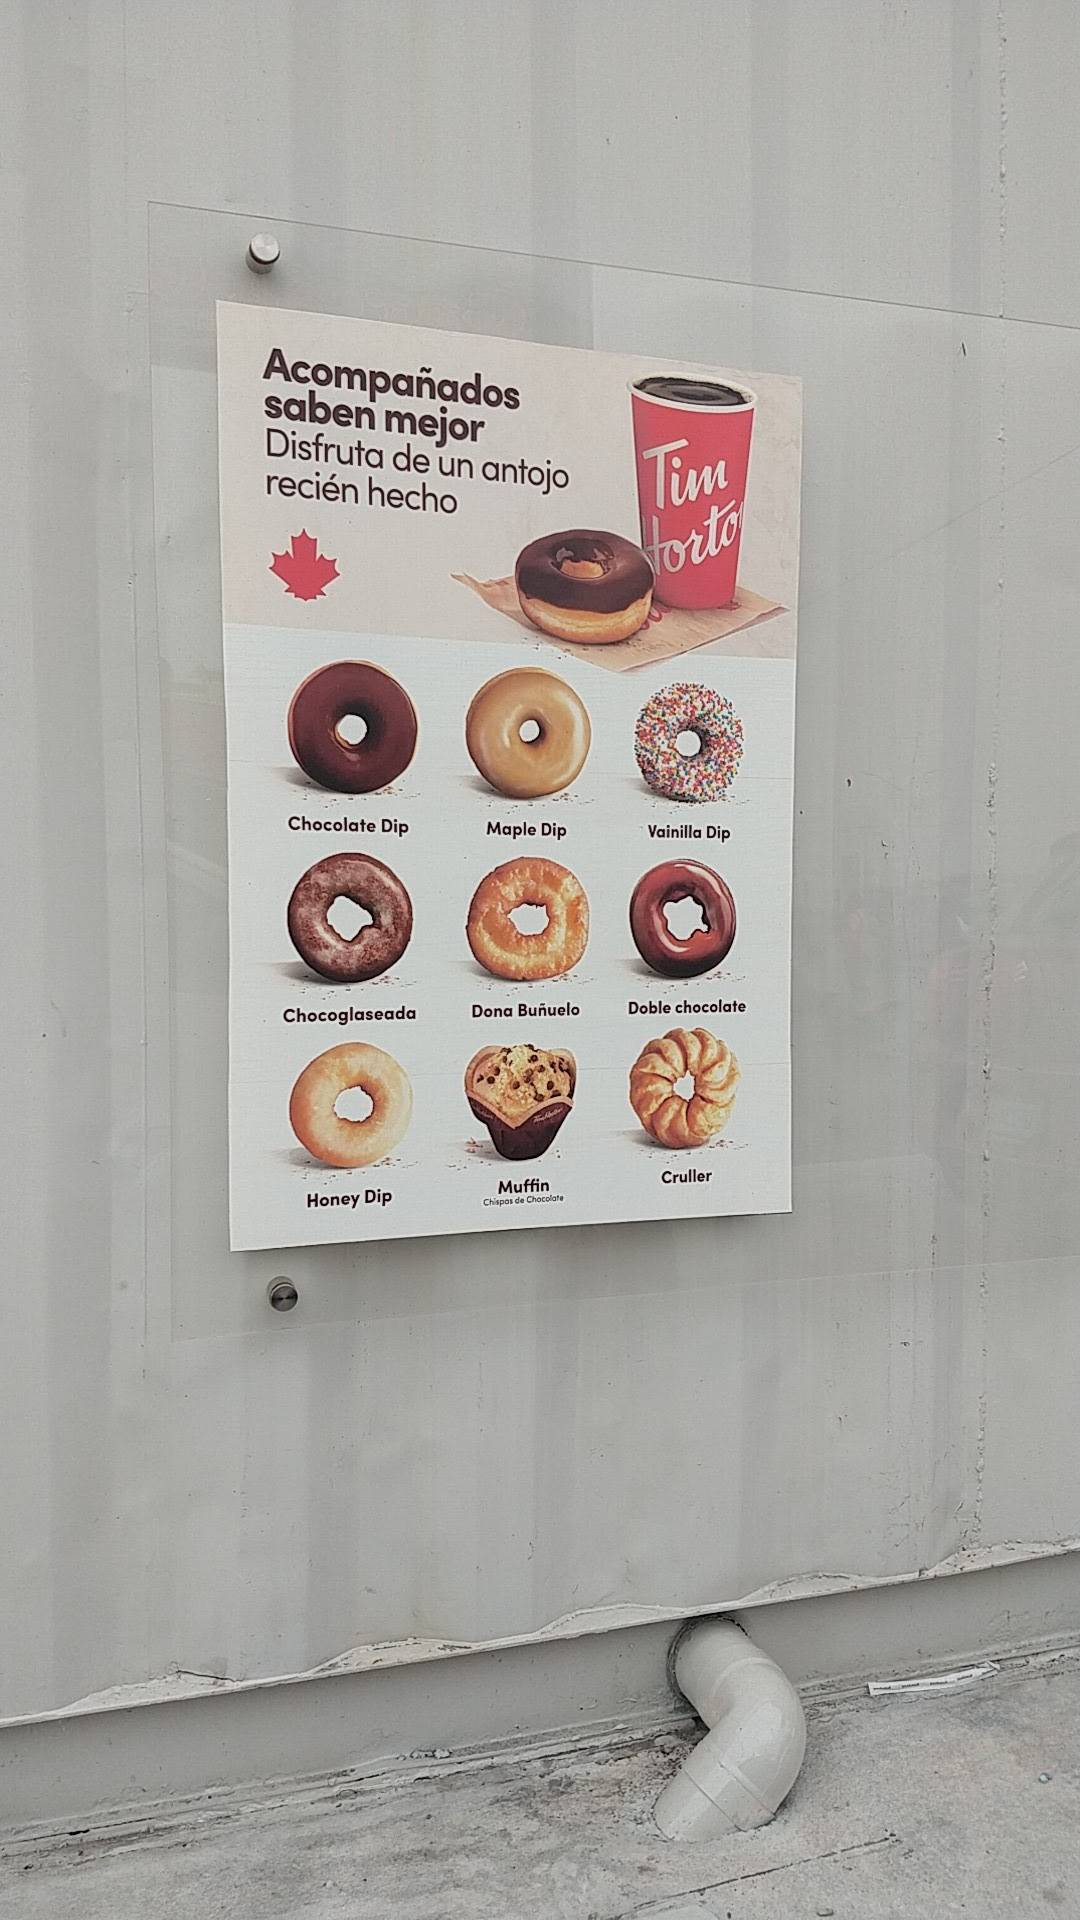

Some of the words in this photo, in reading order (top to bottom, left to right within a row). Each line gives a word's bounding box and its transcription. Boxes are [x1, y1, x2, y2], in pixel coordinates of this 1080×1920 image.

[262, 347, 521, 411] Acompañados
[264, 391, 377, 431] saben
[384, 408, 486, 448] mejor
[266, 427, 384, 471] Disfruta
[391, 442, 431, 475] de
[436, 453, 475, 479] un
[481, 458, 570, 496] antojo
[642, 438, 728, 510] Tim
[265, 473, 359, 506] recién
[367, 475, 459, 515] hecho
[287, 815, 377, 834] Chocolate
[381, 818, 409, 839] Dip
[486, 821, 537, 840] Maple
[541, 822, 567, 841] Dip
[647, 823, 702, 839] Vainilla
[706, 825, 731, 844] Dip
[282, 1005, 416, 1026] Chocoglaseada
[471, 1003, 513, 1019] Dona
[518, 1001, 580, 1018] Buñuelo
[628, 1000, 672, 1015] Doble
[675, 998, 747, 1015] chocolate
[497, 1177, 550, 1195] Muffin
[661, 1168, 713, 1184] Cruller
[306, 1191, 361, 1210] Honey
[364, 1188, 393, 1208] Dip
[482, 1198, 513, 1207] Chispas
[514, 1197, 525, 1205] de
[526, 1194, 564, 1204] Chocolate
